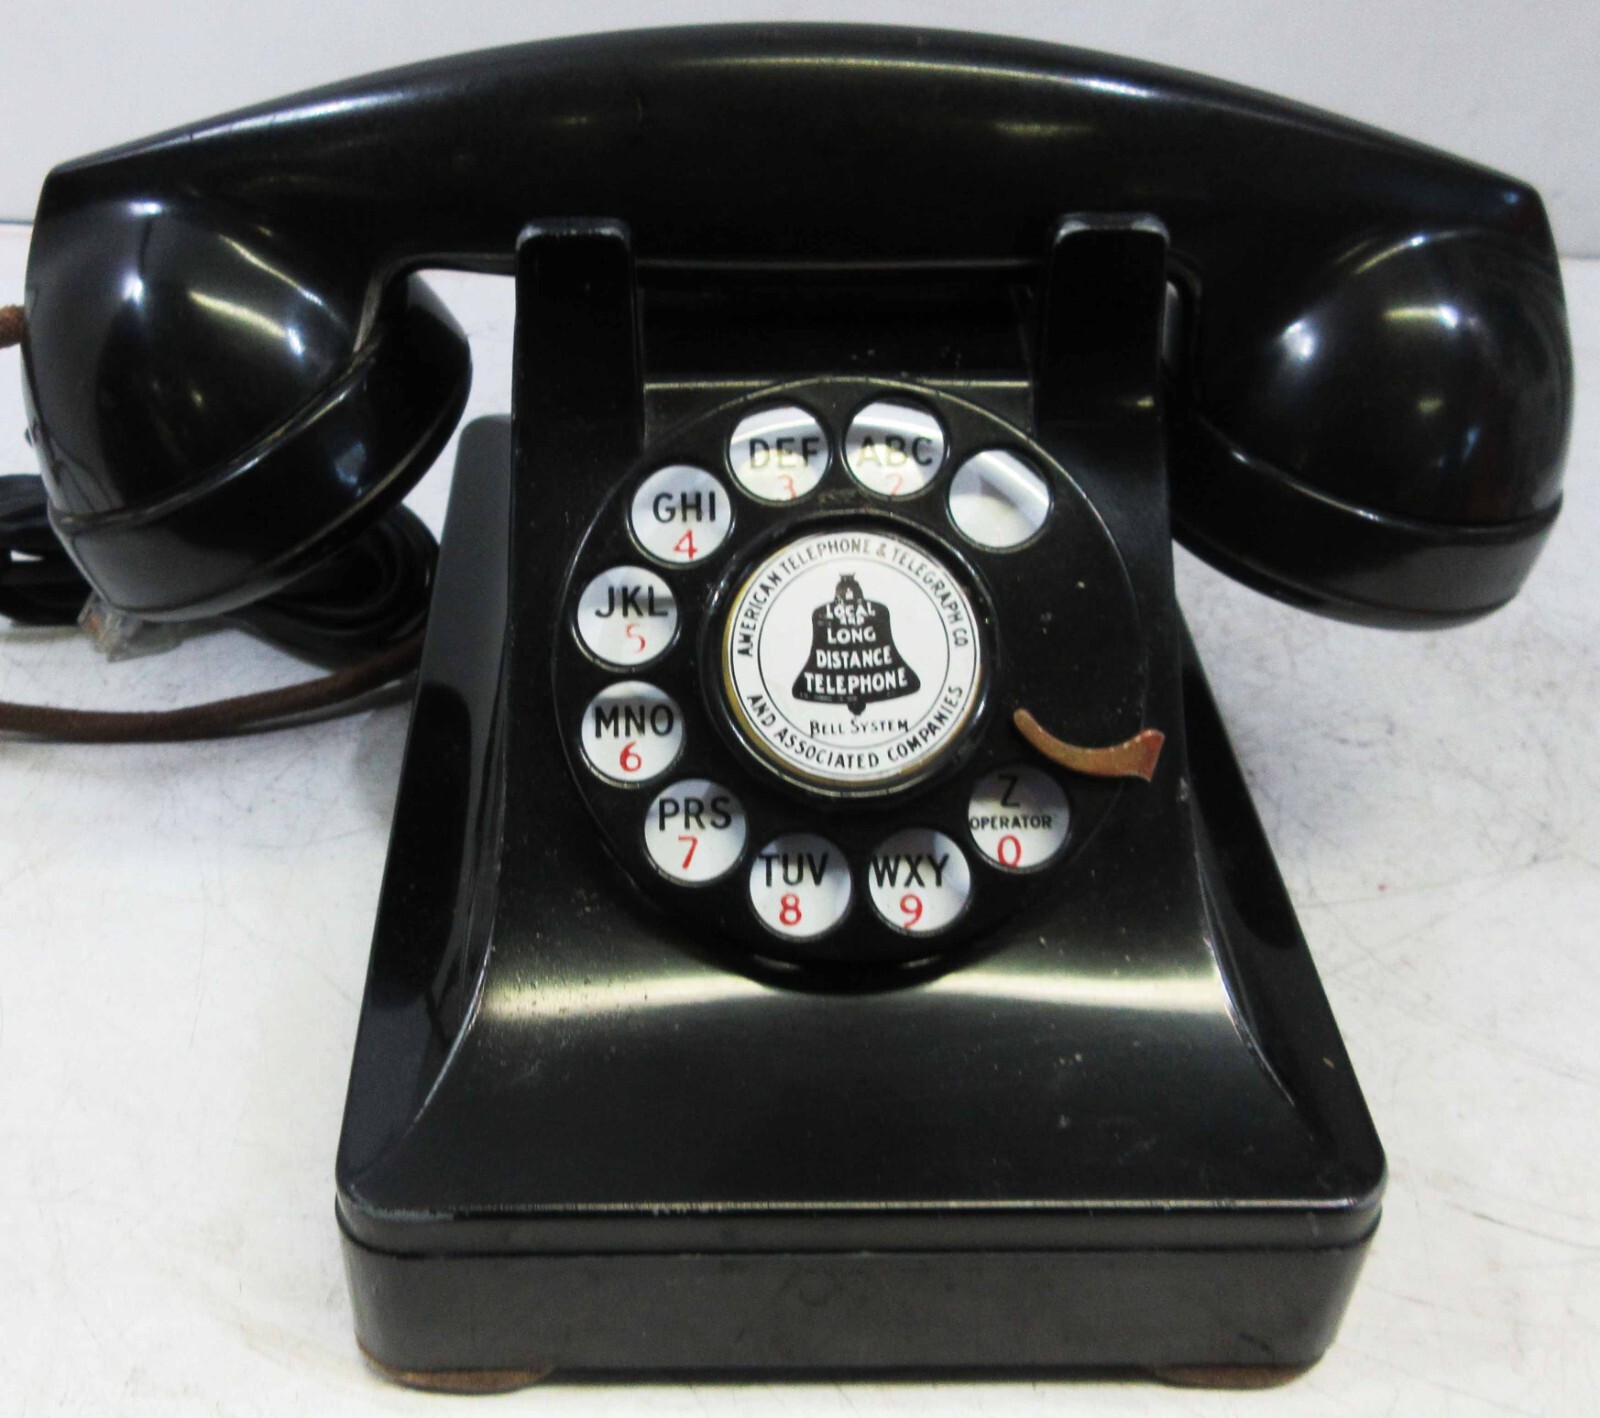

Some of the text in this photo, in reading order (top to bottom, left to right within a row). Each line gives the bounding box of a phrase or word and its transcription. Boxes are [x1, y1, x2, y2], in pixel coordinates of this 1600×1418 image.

[748, 436, 820, 469] DEF
[857, 435, 933, 466] ABC
[777, 474, 798, 499] 3
[886, 472, 903, 496] 2
[652, 491, 716, 523] GHI
[673, 529, 698, 560] 4
[594, 585, 669, 618] JKL
[737, 570, 782, 658] AMERICAN
[780, 538, 870, 574] TELEPHONE
[875, 542, 887, 558] &
[891, 548, 966, 629] TELEGRAPH
[825, 601, 876, 620] LOCAL
[626, 621, 646, 653] 5
[826, 626, 877, 645] LONG
[815, 645, 893, 669] DISTANCE
[803, 667, 908, 695] TELEPHONE
[594, 704, 675, 738] MNO
[747, 685, 963, 770] AND ASSOCIATED COMPANIES
[619, 741, 643, 773] 6
[999, 774, 1021, 808] Z
[658, 796, 732, 831] PRS
[968, 814, 1053, 830] OPERATOR
[678, 835, 698, 869] 7
[997, 834, 1022, 868] 0
[758, 852, 829, 888] TUV
[872, 853, 950, 888] WXY
[779, 893, 802, 926] 8
[900, 893, 923, 928] 9
